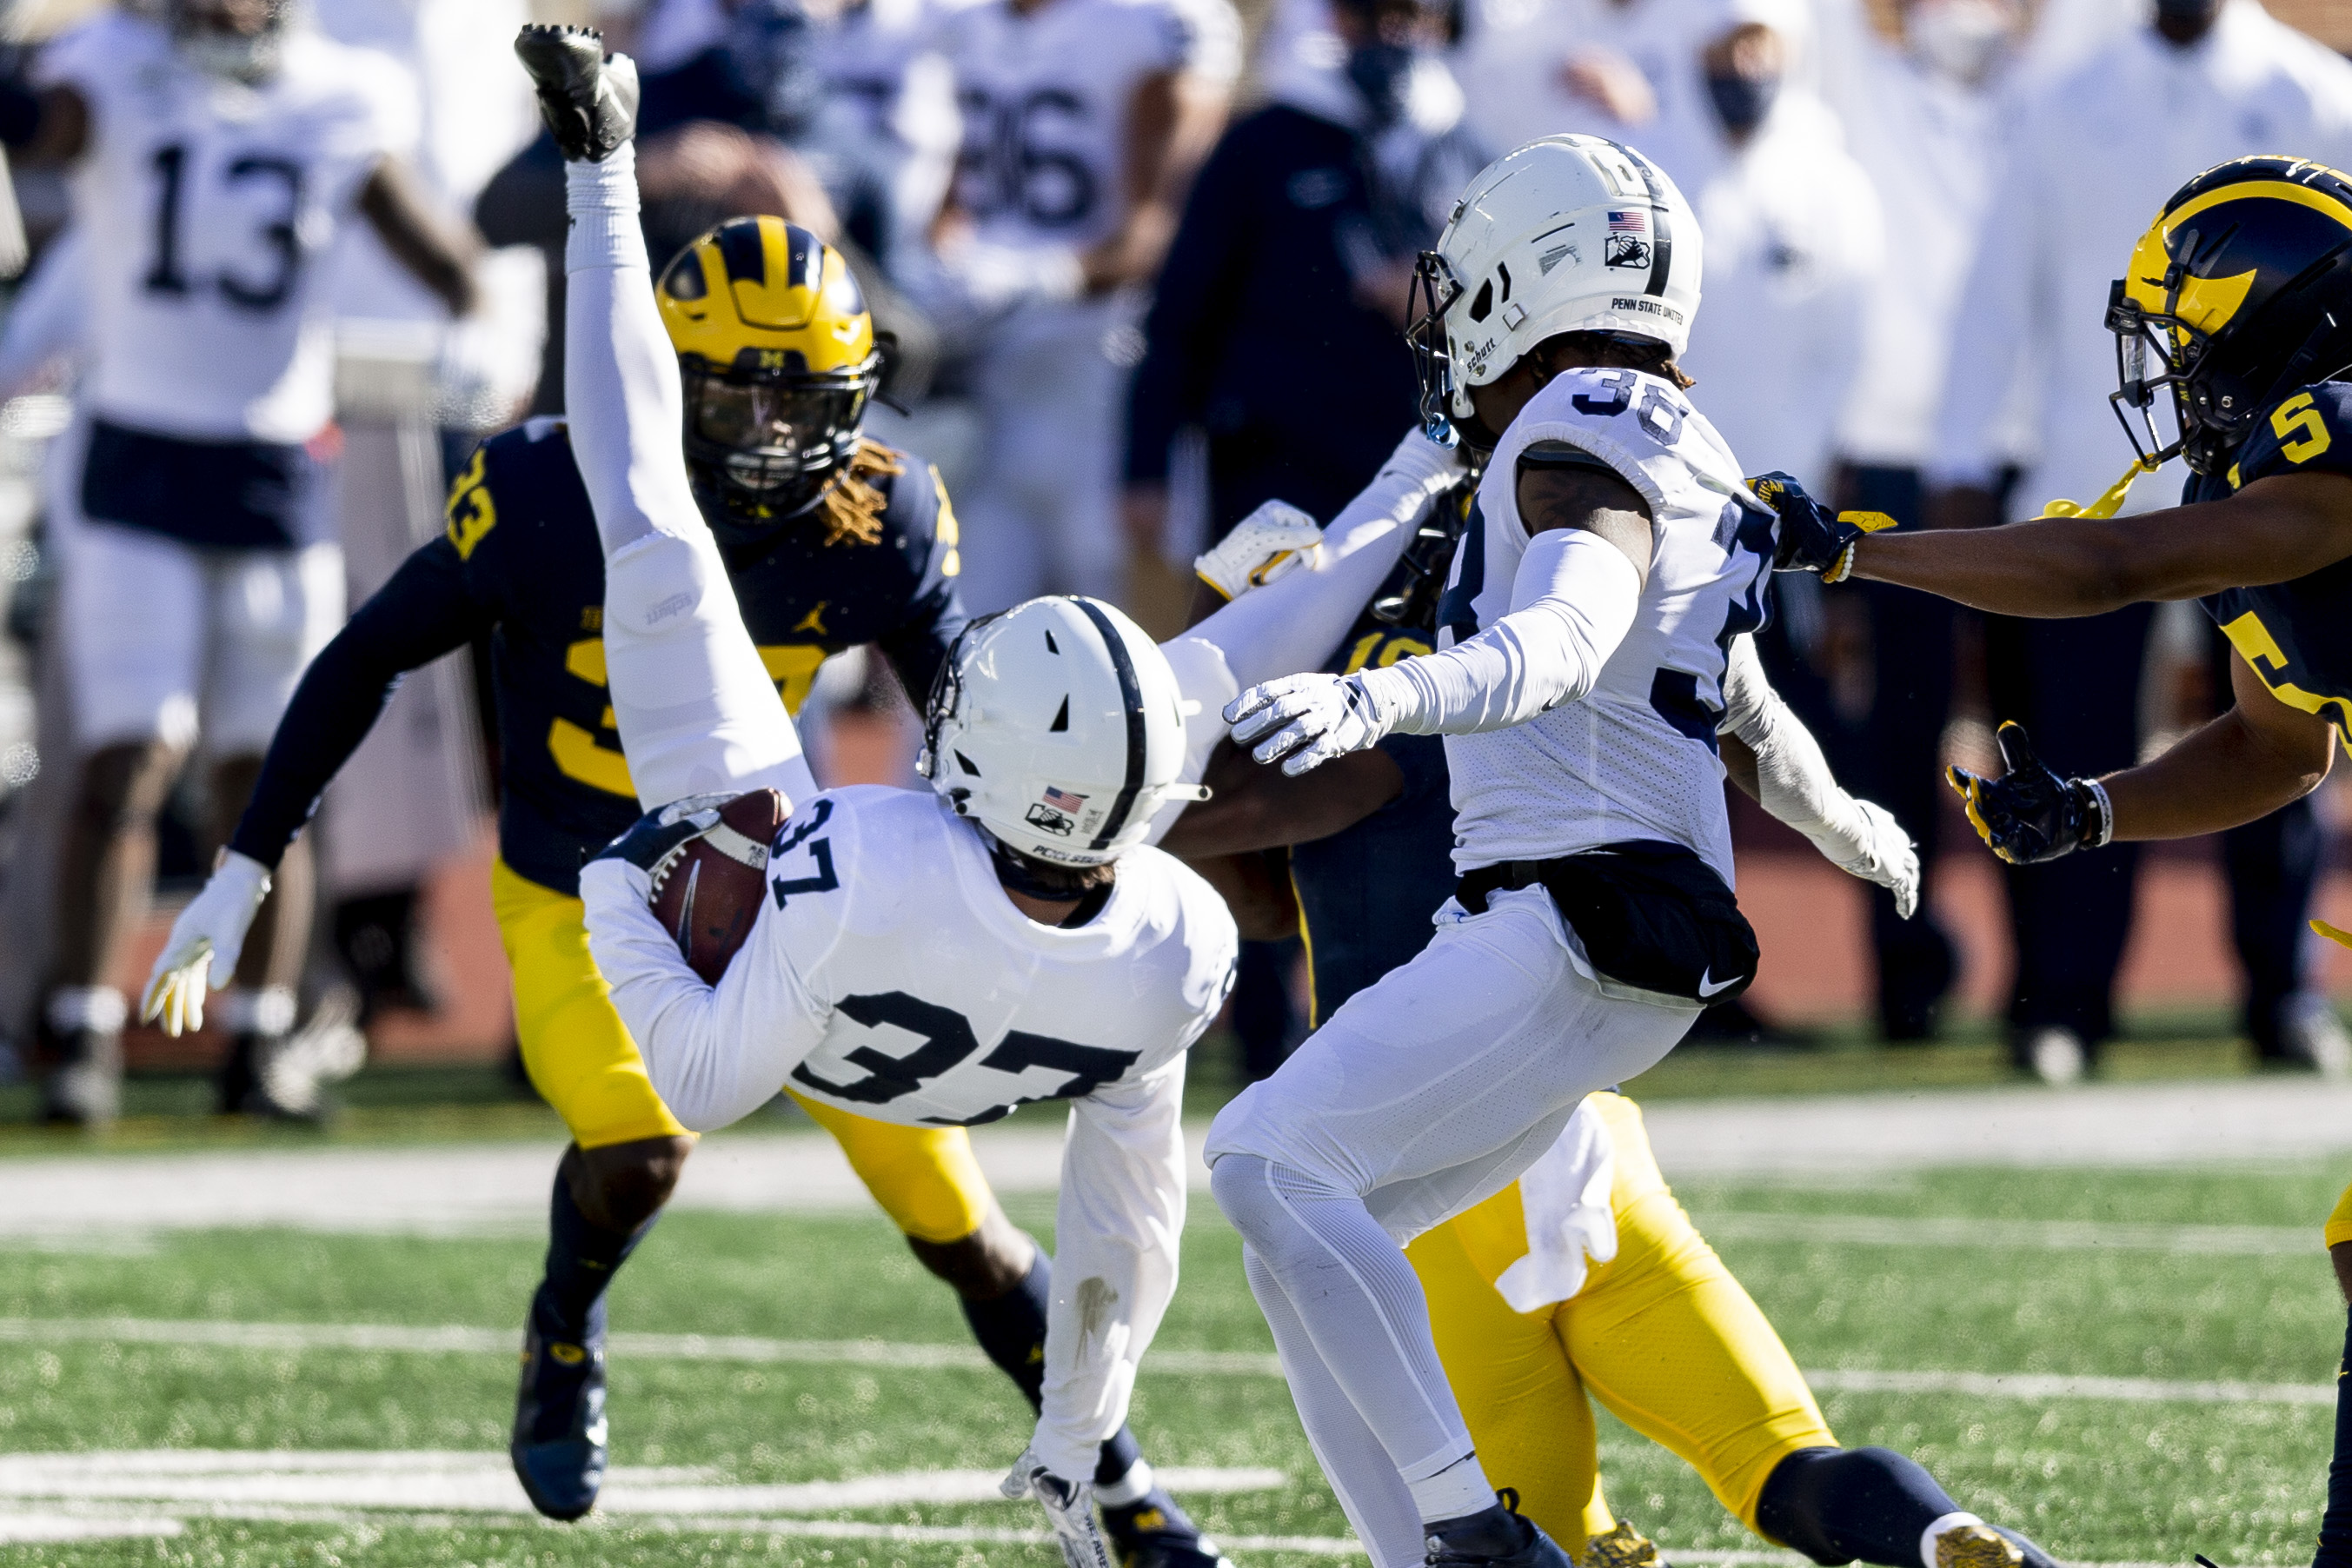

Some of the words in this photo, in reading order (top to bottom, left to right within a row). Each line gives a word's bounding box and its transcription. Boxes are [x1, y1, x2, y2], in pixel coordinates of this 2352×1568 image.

[141, 142, 301, 309] 13
[1611, 297, 1637, 310] PENN
[1638, 300, 1662, 316] STATE
[2165, 312, 2189, 402] MIHIGA
[2269, 392, 2331, 464] 5
[771, 797, 839, 912] 37
[789, 990, 1143, 1128] 37
